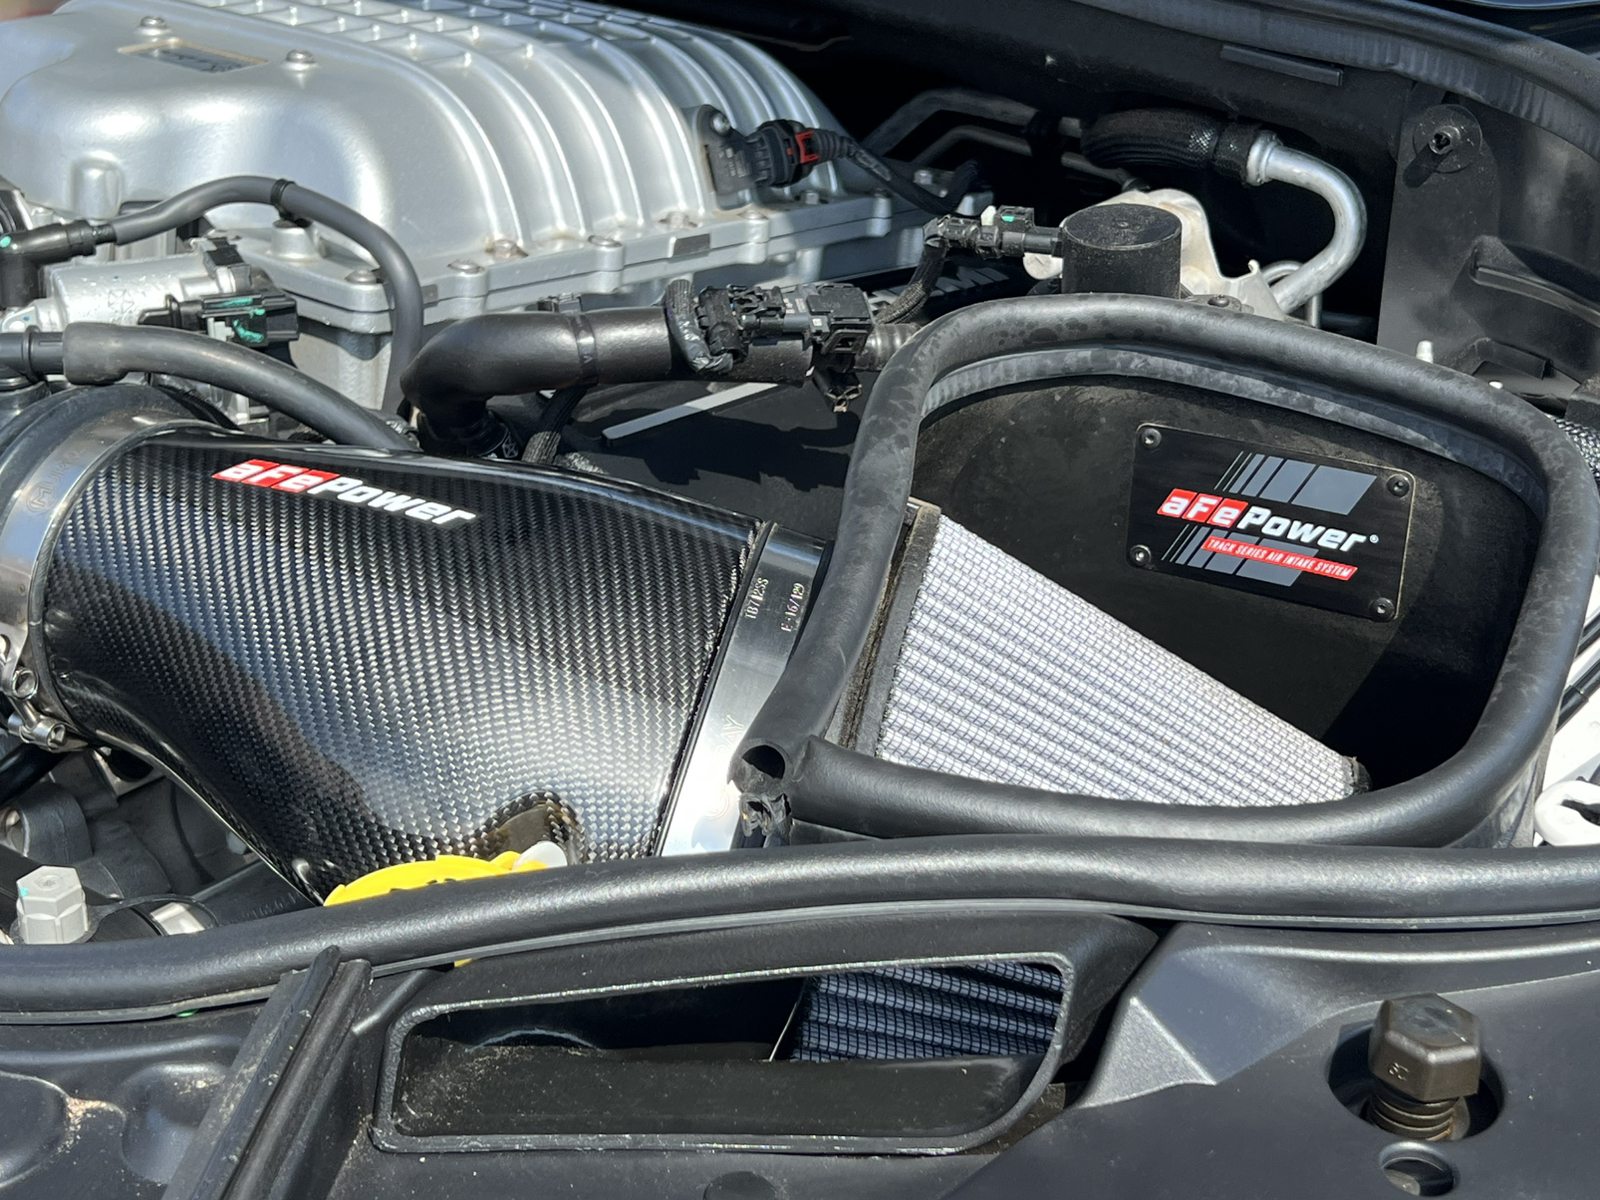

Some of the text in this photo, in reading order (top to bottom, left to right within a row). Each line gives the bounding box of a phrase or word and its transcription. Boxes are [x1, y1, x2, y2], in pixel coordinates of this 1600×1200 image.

[1206, 538, 1353, 578] TRACK SERIES AIR INTAKE SYSTEM
